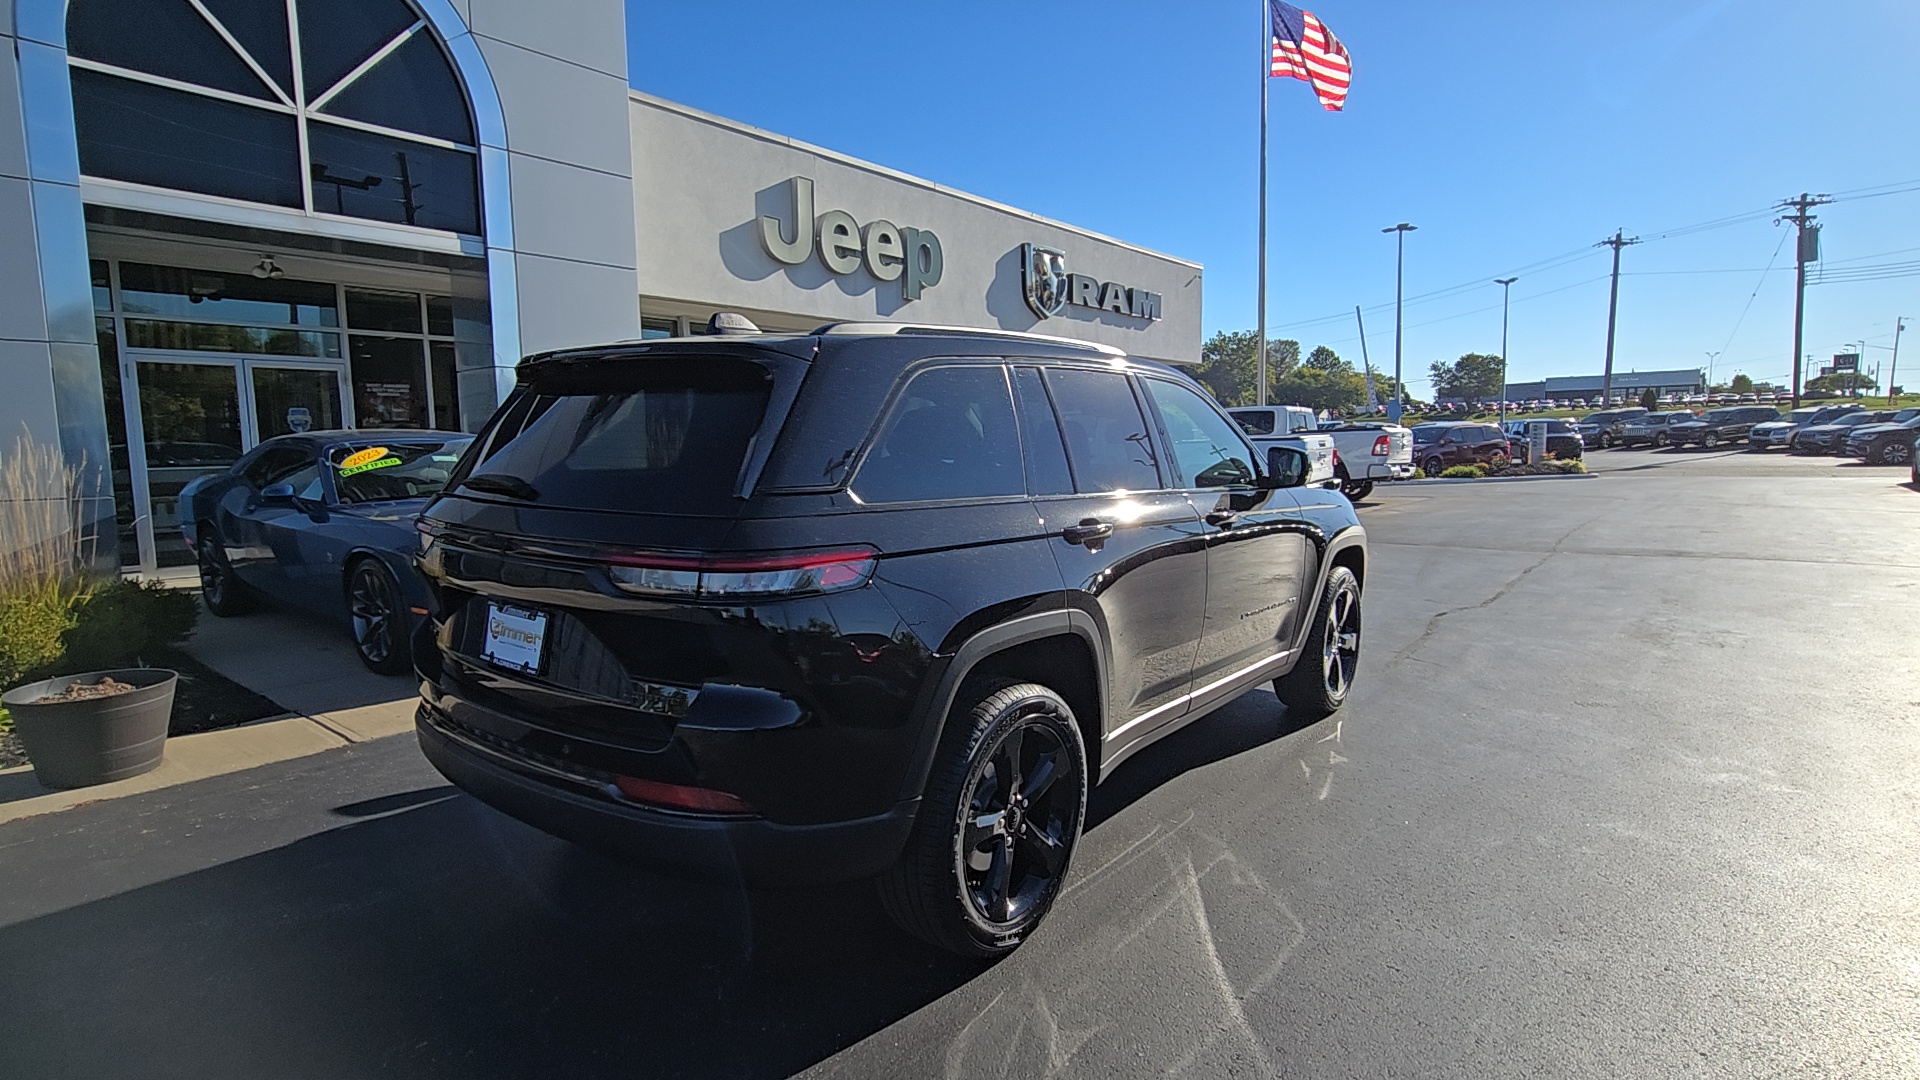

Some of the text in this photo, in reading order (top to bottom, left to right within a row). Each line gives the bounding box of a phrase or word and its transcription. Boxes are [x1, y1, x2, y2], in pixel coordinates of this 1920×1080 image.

[761, 176, 944, 300] Jeep
[1068, 273, 1163, 321] RAM
[341, 459, 398, 476] CERTIFIED
[349, 449, 381, 466] 2023
[490, 618, 542, 646] Zimmer
